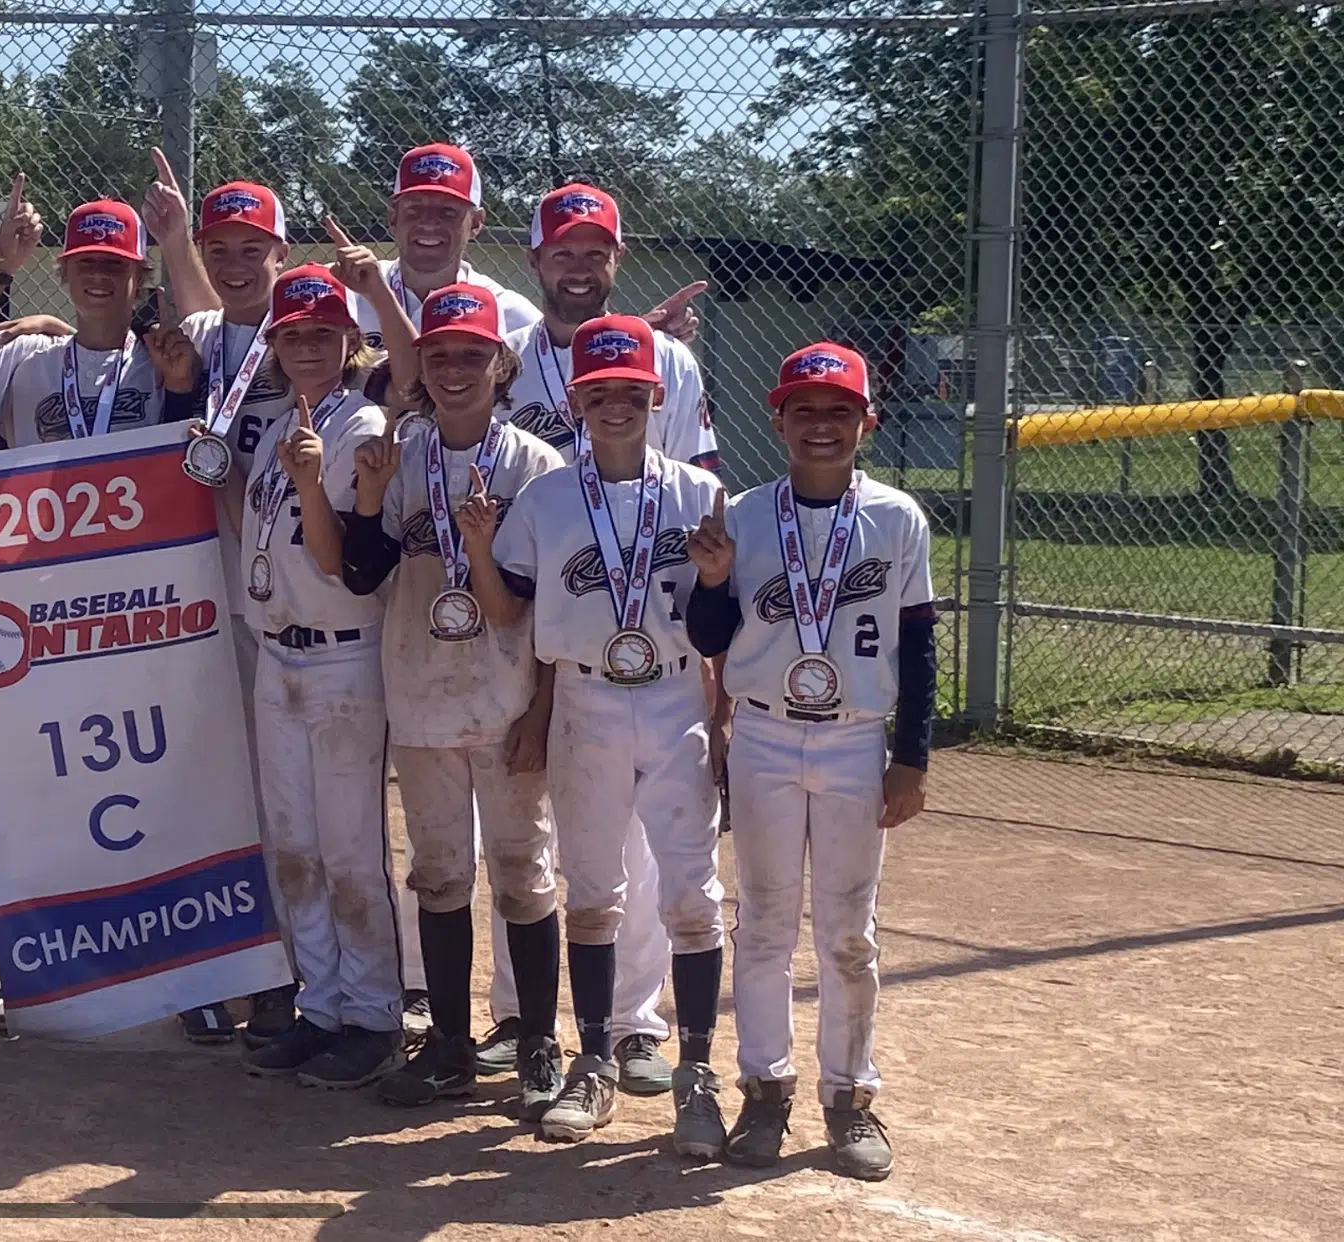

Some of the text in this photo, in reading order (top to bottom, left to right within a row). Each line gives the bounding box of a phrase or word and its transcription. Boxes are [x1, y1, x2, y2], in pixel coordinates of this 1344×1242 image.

[29, 584, 180, 624] BASEBALL
[855, 614, 879, 658] 2
[38, 705, 167, 778] 13U
[89, 794, 146, 852] C
[12, 880, 256, 973] CHAMPIONS
